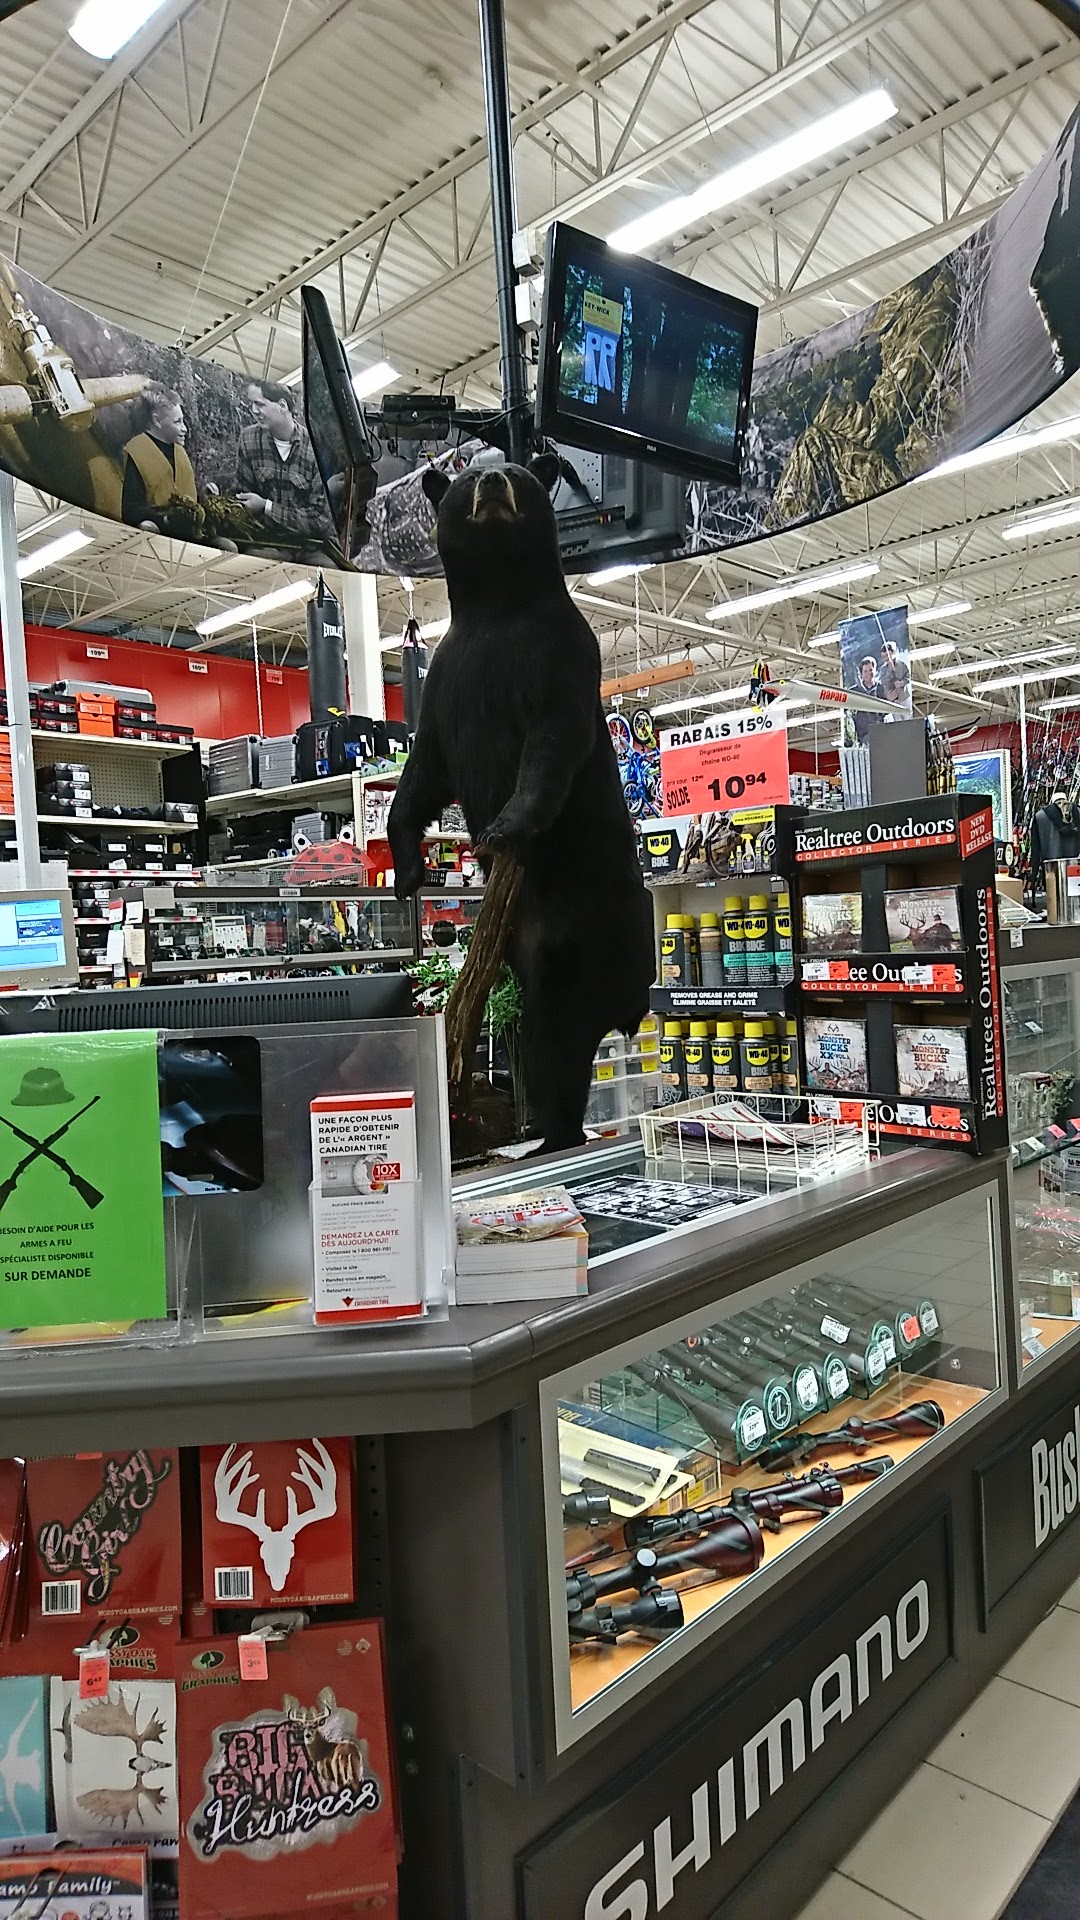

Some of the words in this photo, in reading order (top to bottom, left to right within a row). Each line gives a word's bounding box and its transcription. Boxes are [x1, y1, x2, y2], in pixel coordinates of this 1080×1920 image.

[670, 723, 731, 746] RABAIS
[737, 715, 773, 733] 15%
[699, 745, 733, 756] Dégraisseur
[721, 754, 740, 762] WD-40
[666, 786, 691, 810] SOLDE
[970, 813, 986, 829] NEW
[795, 828, 862, 852] Realtree
[867, 817, 955, 842] Outdoors
[969, 825, 985, 840] DVD
[649, 837, 669, 848] WD-40
[796, 845, 872, 861] COLLECTOR
[892, 834, 954, 849] SERIES
[966, 832, 993, 853] RELEASE
[651, 856, 670, 868] BIKE
[986, 890, 996, 971] SERIES
[746, 939, 766, 951] BIKE
[976, 887, 992, 1009] Outdoors
[802, 982, 878, 991] COLLECTOR
[899, 983, 961, 992] SERIES
[817, 1035, 851, 1044] MONSTER
[819, 1042, 849, 1053] BUCKS
[911, 1045, 950, 1055] MONSTER
[748, 1049, 768, 1058] WD-40
[819, 1051, 834, 1060] XX
[913, 1053, 947, 1063] BUCKS
[992, 1001, 1003, 1116] COLLECTOR
[714, 1064, 730, 1074] BIKE
[750, 1066, 769, 1076] BIKE
[914, 1063, 930, 1071] XX
[981, 1016, 997, 1119] Realtree
[338, 1115, 369, 1124] FAÇON
[371, 1114, 393, 1122] PLUS
[318, 1126, 351, 1134] RAPIDE
[353, 1123, 400, 1132] D'OBTENIR
[906, 1127, 968, 1141] SERIES
[318, 1136, 331, 1144] DE
[347, 1134, 383, 1142] ARGENT
[319, 1145, 366, 1154] CANADIAN
[375, 1164, 397, 1175] 10X
[27, 1225, 55, 1234] D'AIDE
[56, 1223, 80, 1232] POUR
[81, 1222, 95, 1230] LES
[321, 1232, 362, 1240] DEMANDEZ
[375, 1229, 400, 1237] CARTE
[20, 1240, 48, 1248] ARMES
[49, 1239, 56, 1247] A
[57, 1238, 73, 1247] FEU
[337, 1238, 389, 1246] AUJOURD'HUI!
[0, 1254, 46, 1263] SPÉCIALISTE
[48, 1251, 94, 1261] DISPONIBLE
[325, 1248, 351, 1256] Composez
[4, 1271, 29, 1282] SUR
[31, 1267, 91, 1280] DEMANDE
[40, 1450, 170, 1572] Country
[270, 1593, 350, 1603] MOSSYOAKGRAPHICS.COM
[98, 1605, 178, 1616] MOSSYOAKGRAPHICS.COM
[182, 1675, 240, 1691] GRAPHICS
[219, 1721, 309, 1782] BIG
[585, 1579, 930, 1920] SHIMANO
[205, 1771, 377, 1853] Huntress
